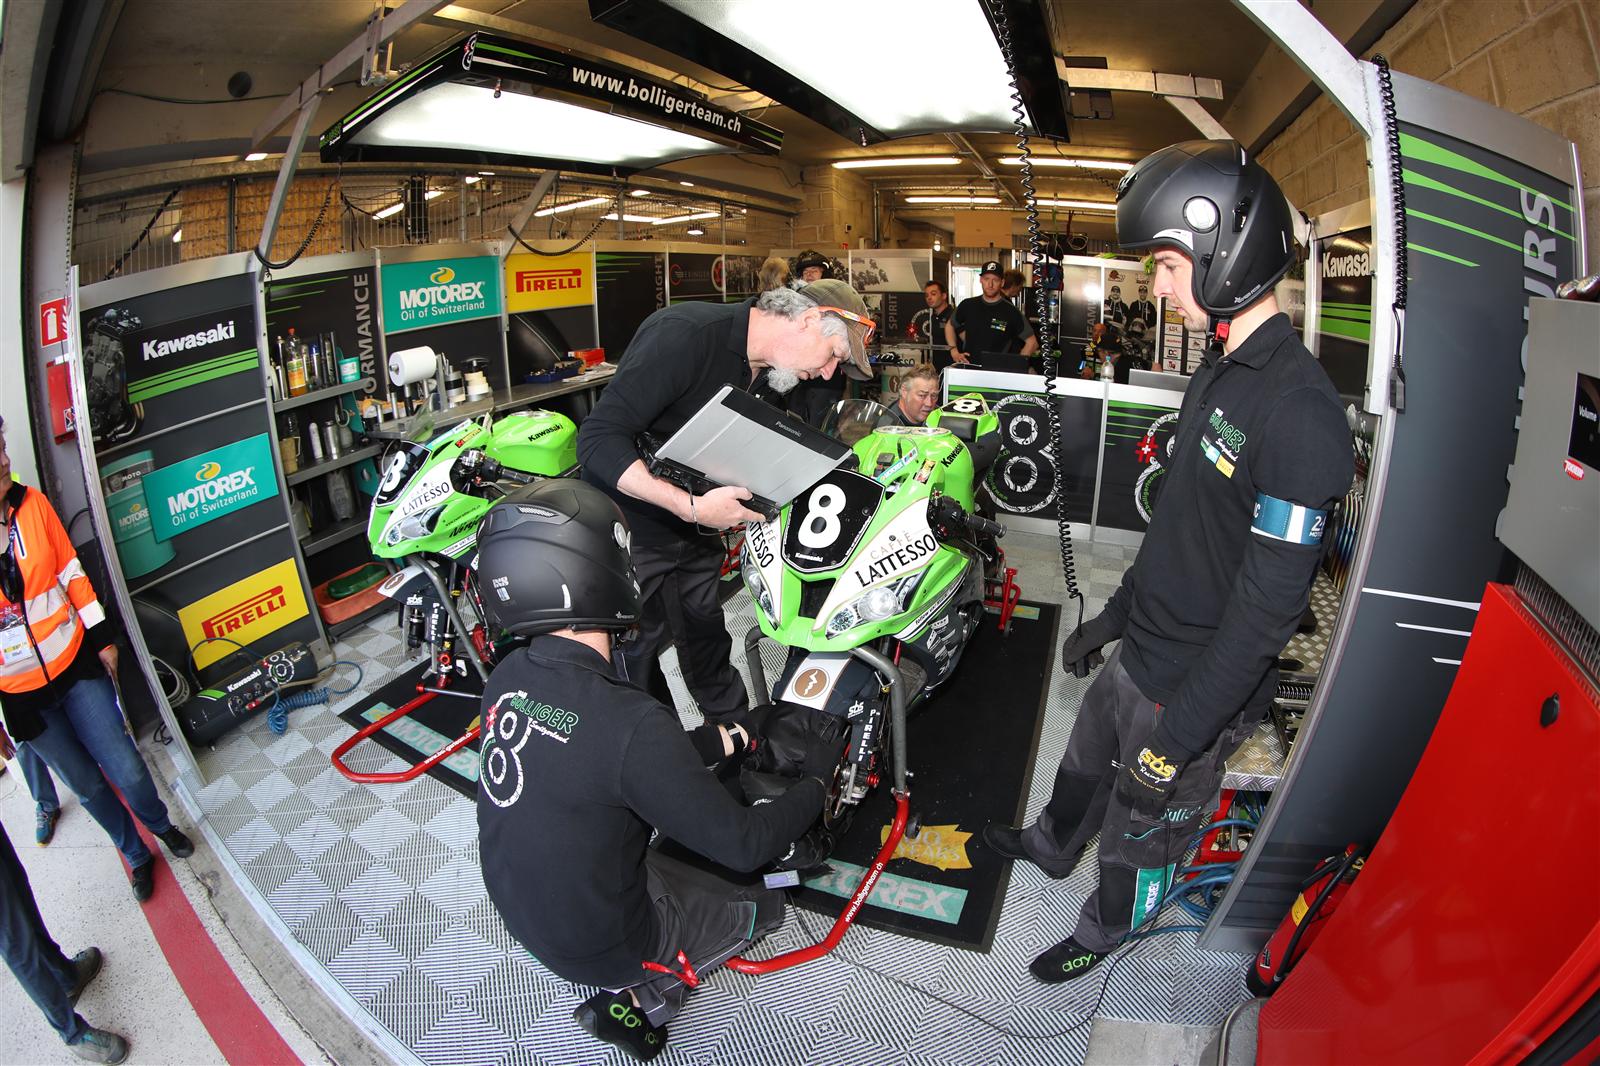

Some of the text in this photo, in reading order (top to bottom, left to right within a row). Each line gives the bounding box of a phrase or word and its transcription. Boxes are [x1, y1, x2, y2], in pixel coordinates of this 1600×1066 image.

[572, 66, 742, 133] www.bolligerteam.ch
[515, 268, 582, 293] PIRELLI
[1322, 251, 1370, 278] Kawasa
[400, 281, 485, 310] MOTOREX
[401, 300, 485, 321] Oil of Switzerland
[888, 293, 898, 330] SPIRIT
[142, 320, 235, 361] Kawasaki
[528, 422, 564, 443] Kawasaki
[775, 420, 803, 438] Panasonic
[121, 470, 141, 482] MOTO
[381, 450, 406, 492] 8
[168, 466, 256, 516] MOTOREX
[172, 486, 258, 527] Oil of Switzerland
[402, 481, 450, 516] LATTESSO
[797, 483, 847, 549] 8
[855, 533, 937, 588] LATTESSO
[201, 585, 286, 644] PIRELLI
[227, 669, 262, 692] Kawasaki
[510, 694, 579, 735] BOLLIGER
[847, 700, 865, 719] sbs
[858, 708, 879, 762] PIRELLI
